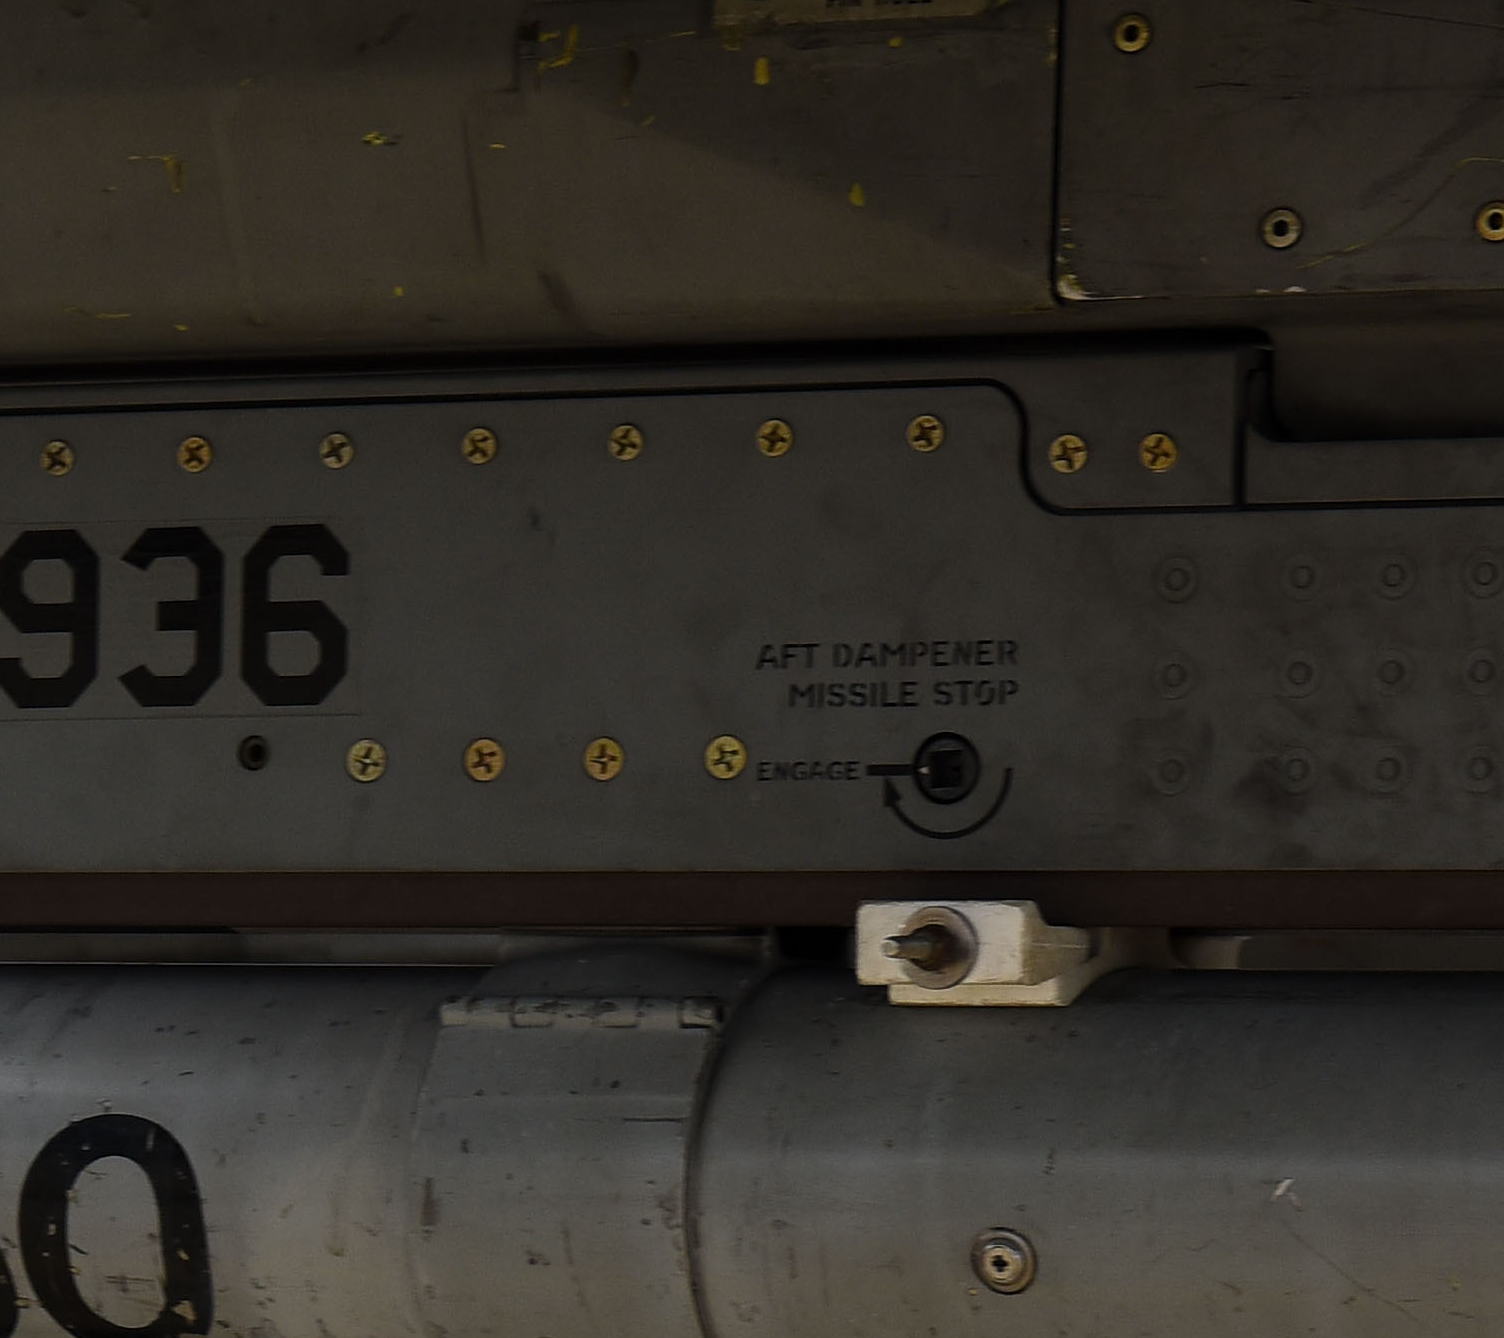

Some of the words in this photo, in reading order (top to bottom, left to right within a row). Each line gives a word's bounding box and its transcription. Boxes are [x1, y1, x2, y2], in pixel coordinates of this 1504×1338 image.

[754, 642, 821, 670] AFT
[831, 640, 1020, 668] DAMPENER
[787, 680, 919, 708] MISSILE
[932, 678, 1020, 706] STOP
[756, 761, 861, 782] ENGAGE
